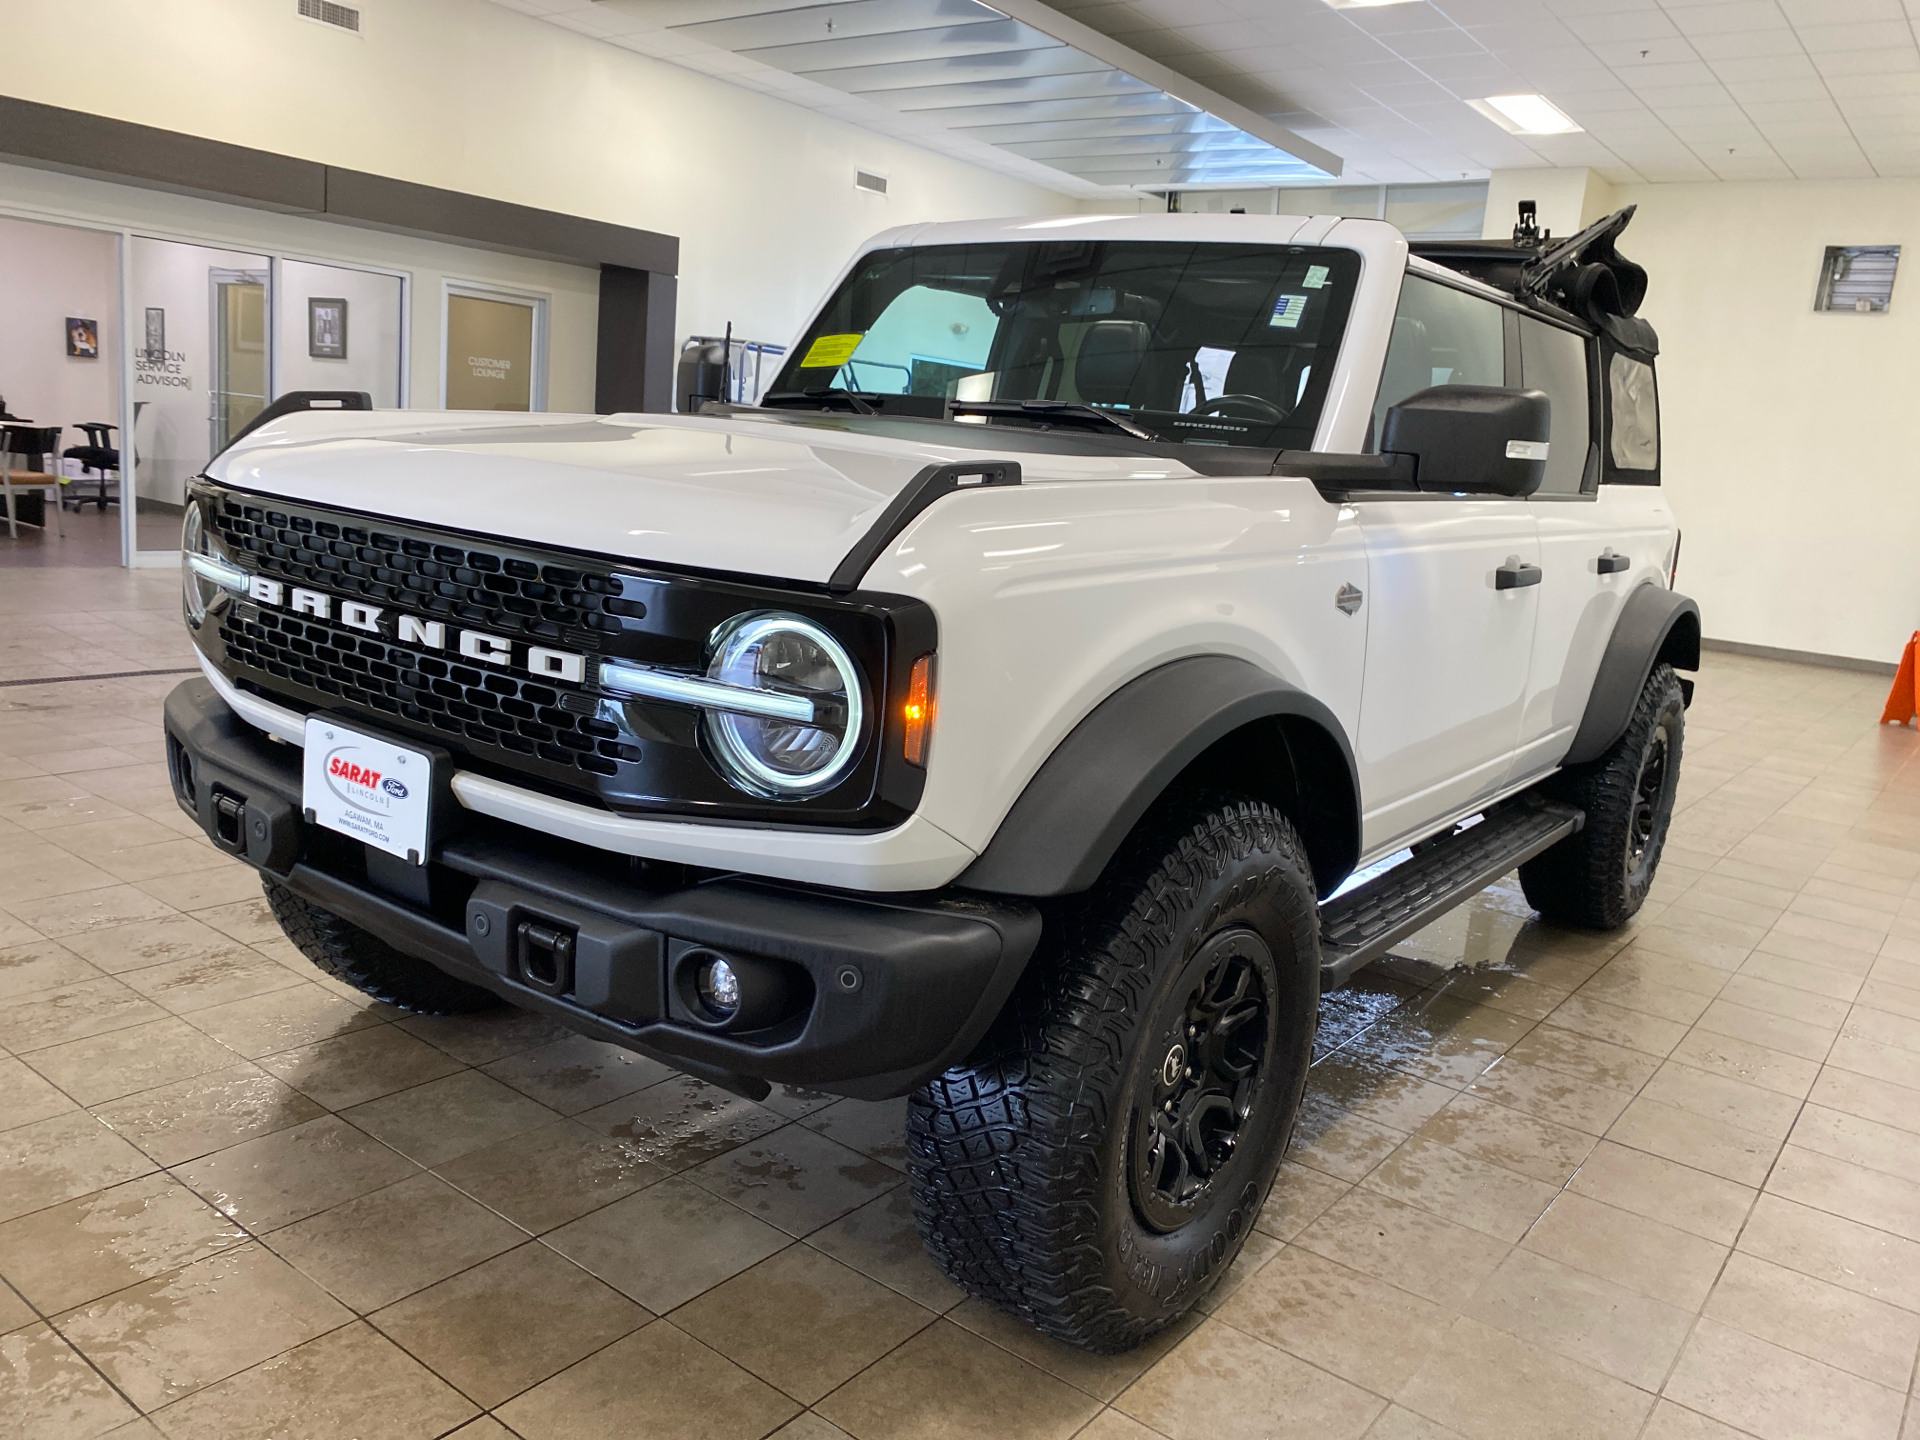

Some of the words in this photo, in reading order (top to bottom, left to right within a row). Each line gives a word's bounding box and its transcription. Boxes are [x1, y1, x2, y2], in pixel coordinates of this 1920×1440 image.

[135, 348, 185, 362] LINCOLN
[468, 356, 510, 369] CUSTOMER
[135, 360, 181, 374] SERVICE
[473, 367, 505, 379] LOUNGE
[136, 374, 188, 387] ADVISOR
[250, 575, 586, 683] BRONCO
[328, 757, 382, 790] SARAT
[352, 786, 385, 804] LINCOLN
[385, 779, 405, 798] Ford
[345, 809, 373, 828] AGAWAM,
[374, 820, 384, 831] MA
